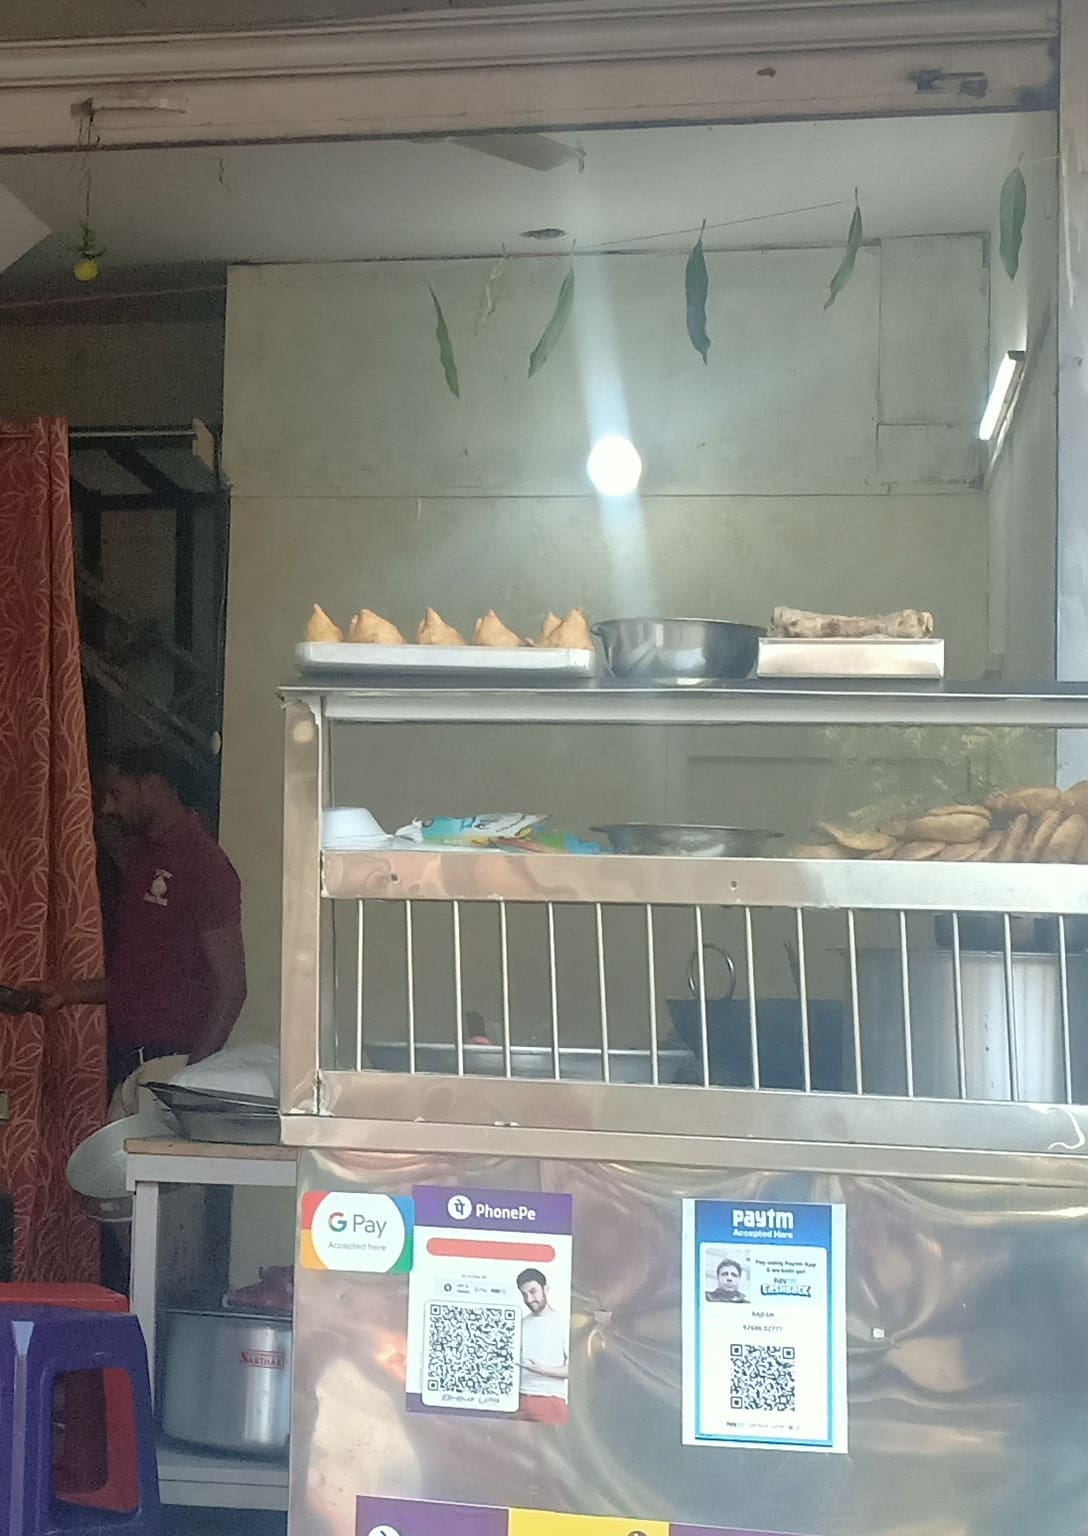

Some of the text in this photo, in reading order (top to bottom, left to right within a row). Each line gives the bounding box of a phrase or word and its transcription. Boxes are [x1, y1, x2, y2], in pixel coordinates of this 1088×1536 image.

[475, 1203, 536, 1221] PhonePe
[352, 1214, 387, 1239] Pay
[732, 1228, 794, 1240] Accepted Here
[327, 1240, 387, 1252] Accepted here
